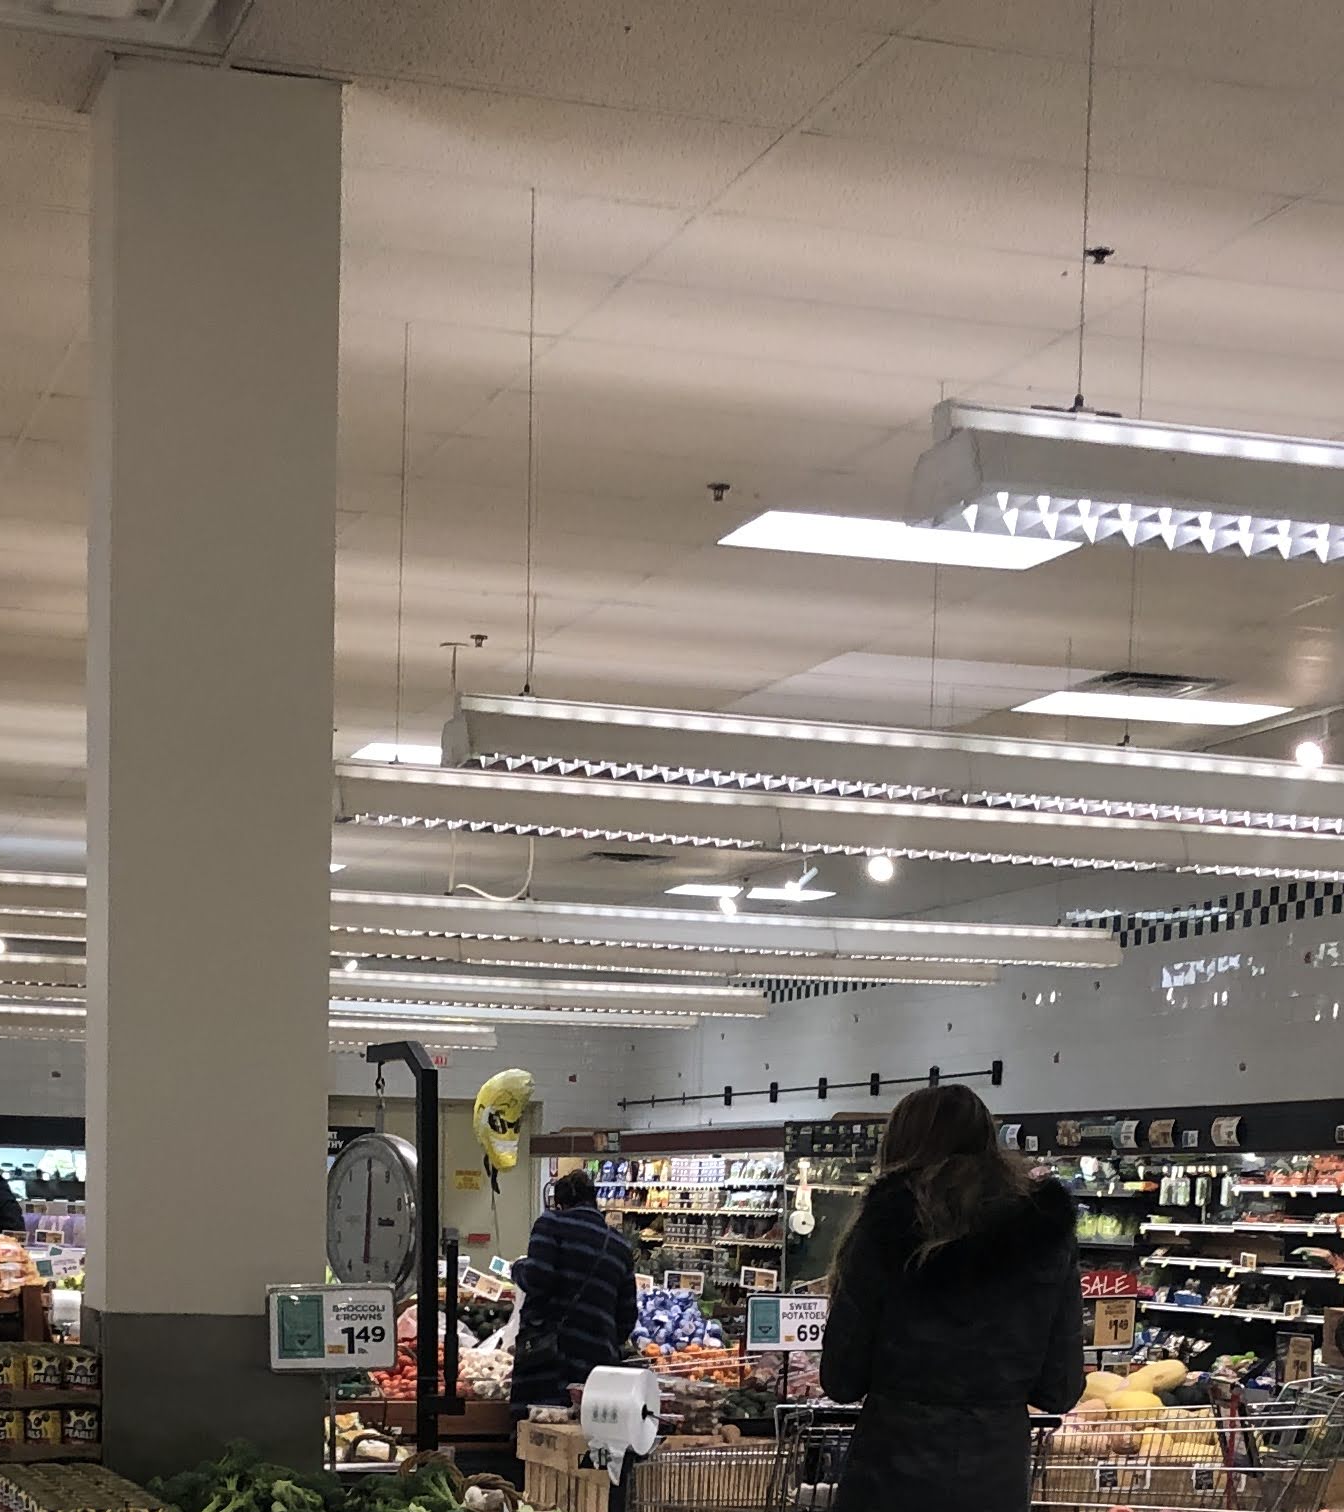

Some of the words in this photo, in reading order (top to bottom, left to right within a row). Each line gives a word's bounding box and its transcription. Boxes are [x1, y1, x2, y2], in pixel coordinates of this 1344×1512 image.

[1080, 1274, 1130, 1296] SALE
[789, 1302, 818, 1310] SWEET
[782, 1311, 826, 1320] POTATOES
